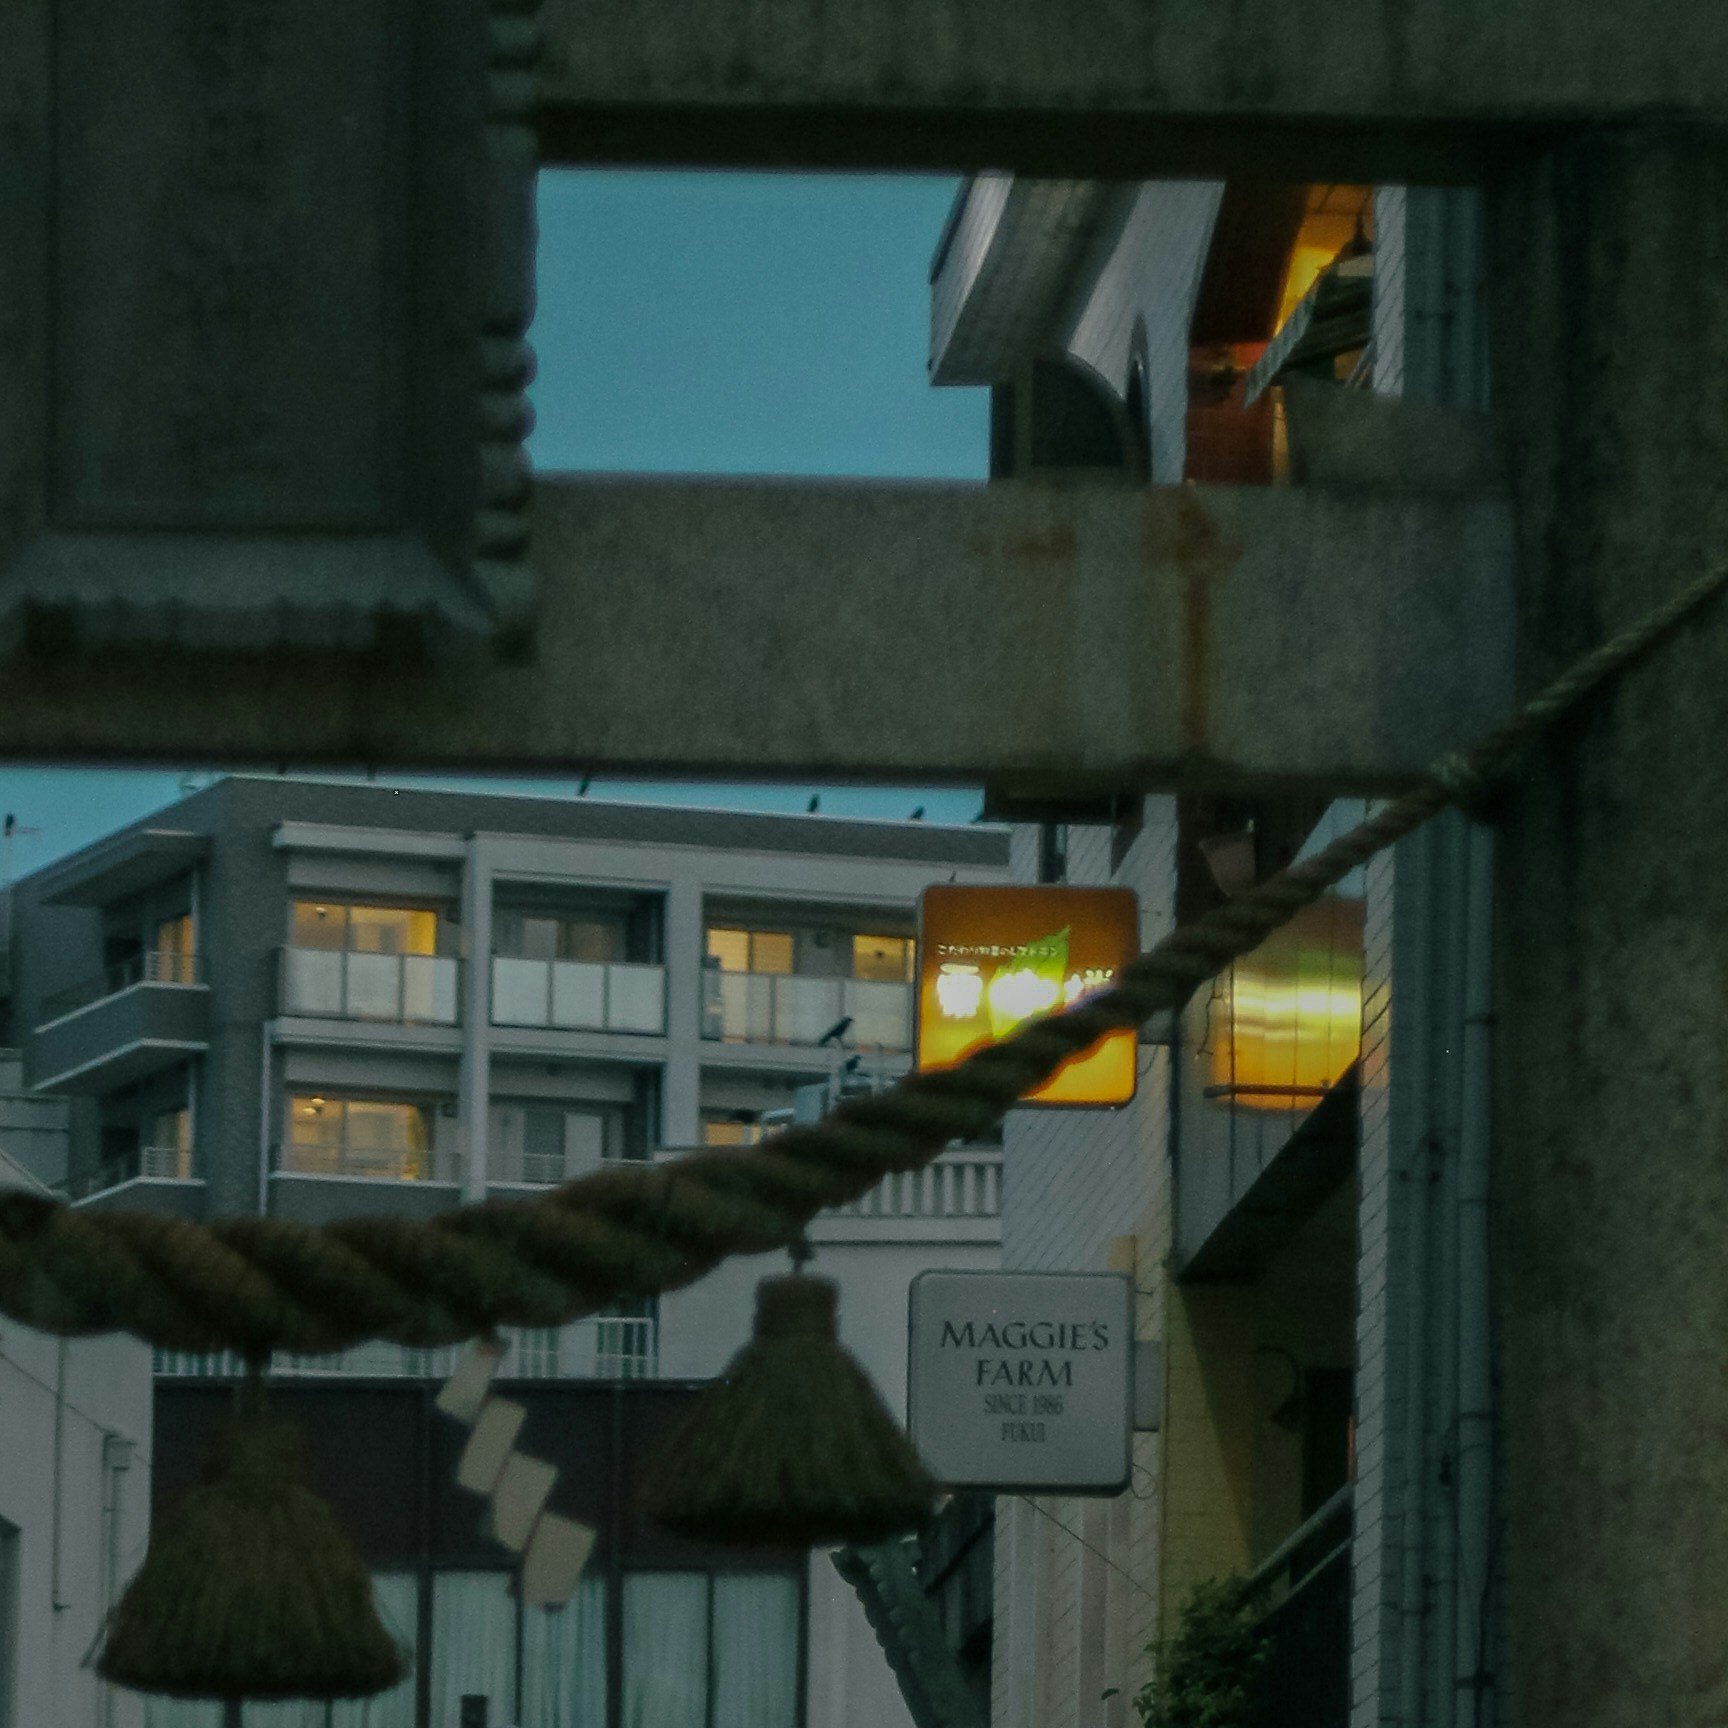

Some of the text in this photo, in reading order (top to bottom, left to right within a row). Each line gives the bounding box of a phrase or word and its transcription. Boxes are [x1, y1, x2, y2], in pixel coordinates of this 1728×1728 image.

[940, 1320, 1109, 1350] MAGGIE'S
[976, 1360, 1073, 1386] FARM
[984, 1394, 1027, 1415] SINCE
[1001, 1422, 1045, 1442] FUKUI
